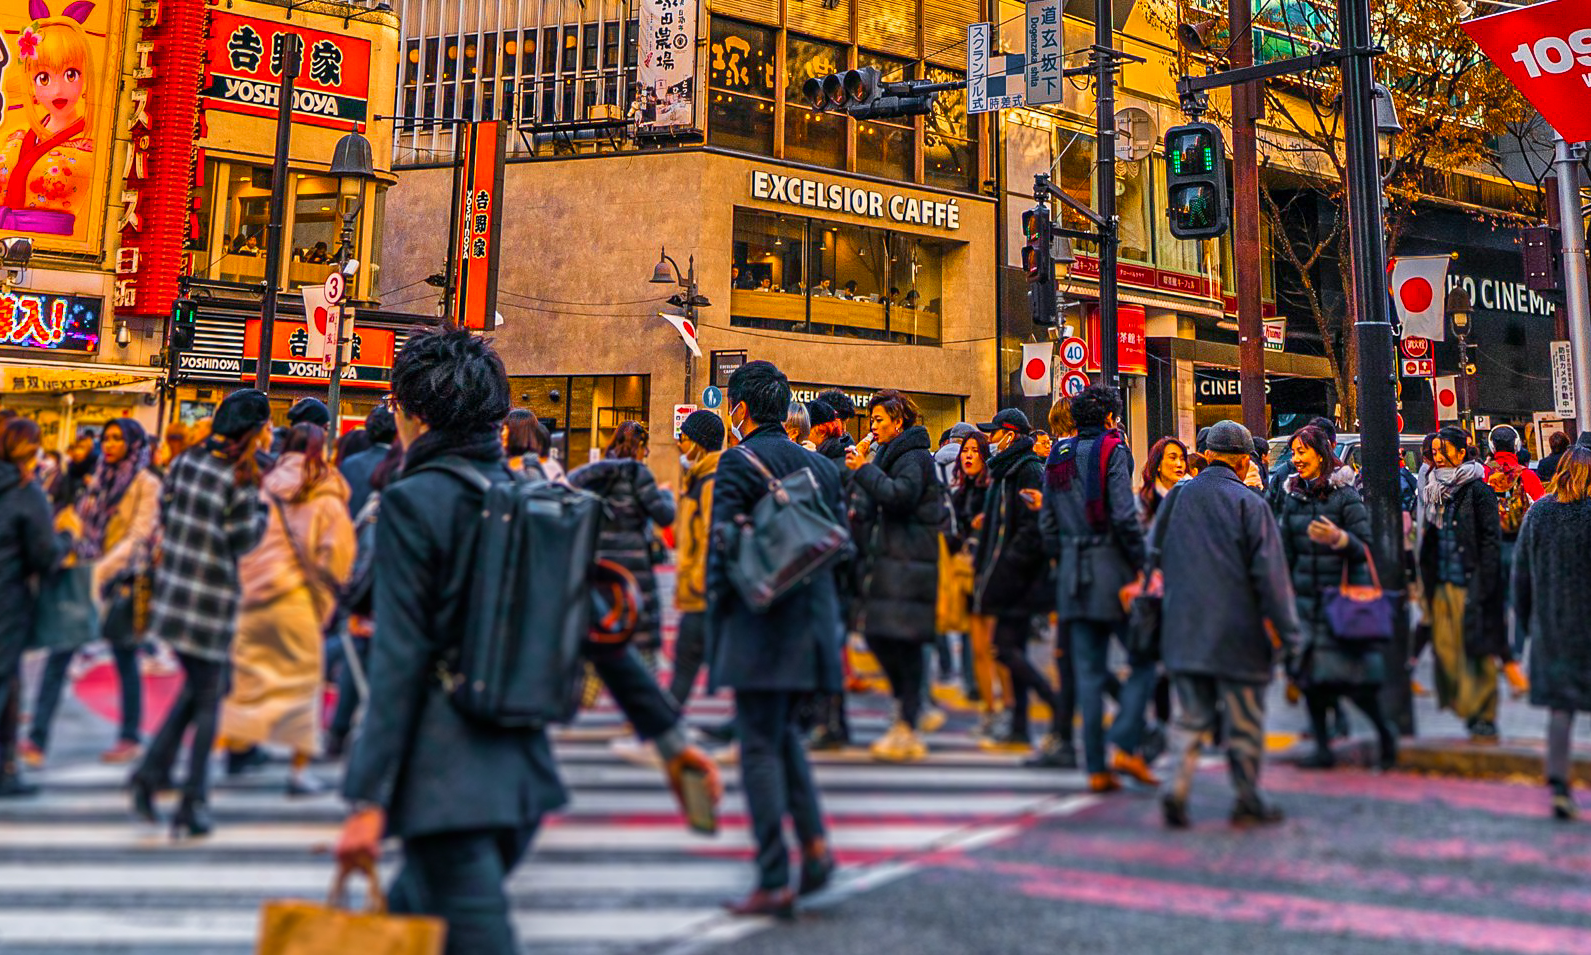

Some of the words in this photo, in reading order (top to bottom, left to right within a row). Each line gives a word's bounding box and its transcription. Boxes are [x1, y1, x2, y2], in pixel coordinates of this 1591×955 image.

[226, 24, 343, 87] 吉野家
[1029, 16, 1040, 64] Dogenzaka
[1040, 5, 1058, 96] 道玄坂下
[972, 26, 985, 109] スクランブル式
[1030, 66, 1040, 87] shita
[224, 79, 339, 116] YOSHNOYA
[989, 94, 1023, 109] 時差式
[752, 170, 884, 217] EXCELSIOR
[889, 194, 960, 230] CAFFÉ
[462, 189, 473, 260] YOSHINOYA
[471, 189, 491, 259] 吉野家
[328, 277, 340, 299] 3
[180, 356, 241, 372] YOSHINOYA
[1066, 345, 1082, 361] 40
[12, 375, 39, 390] 無双
[43, 379, 76, 391] NEXT
